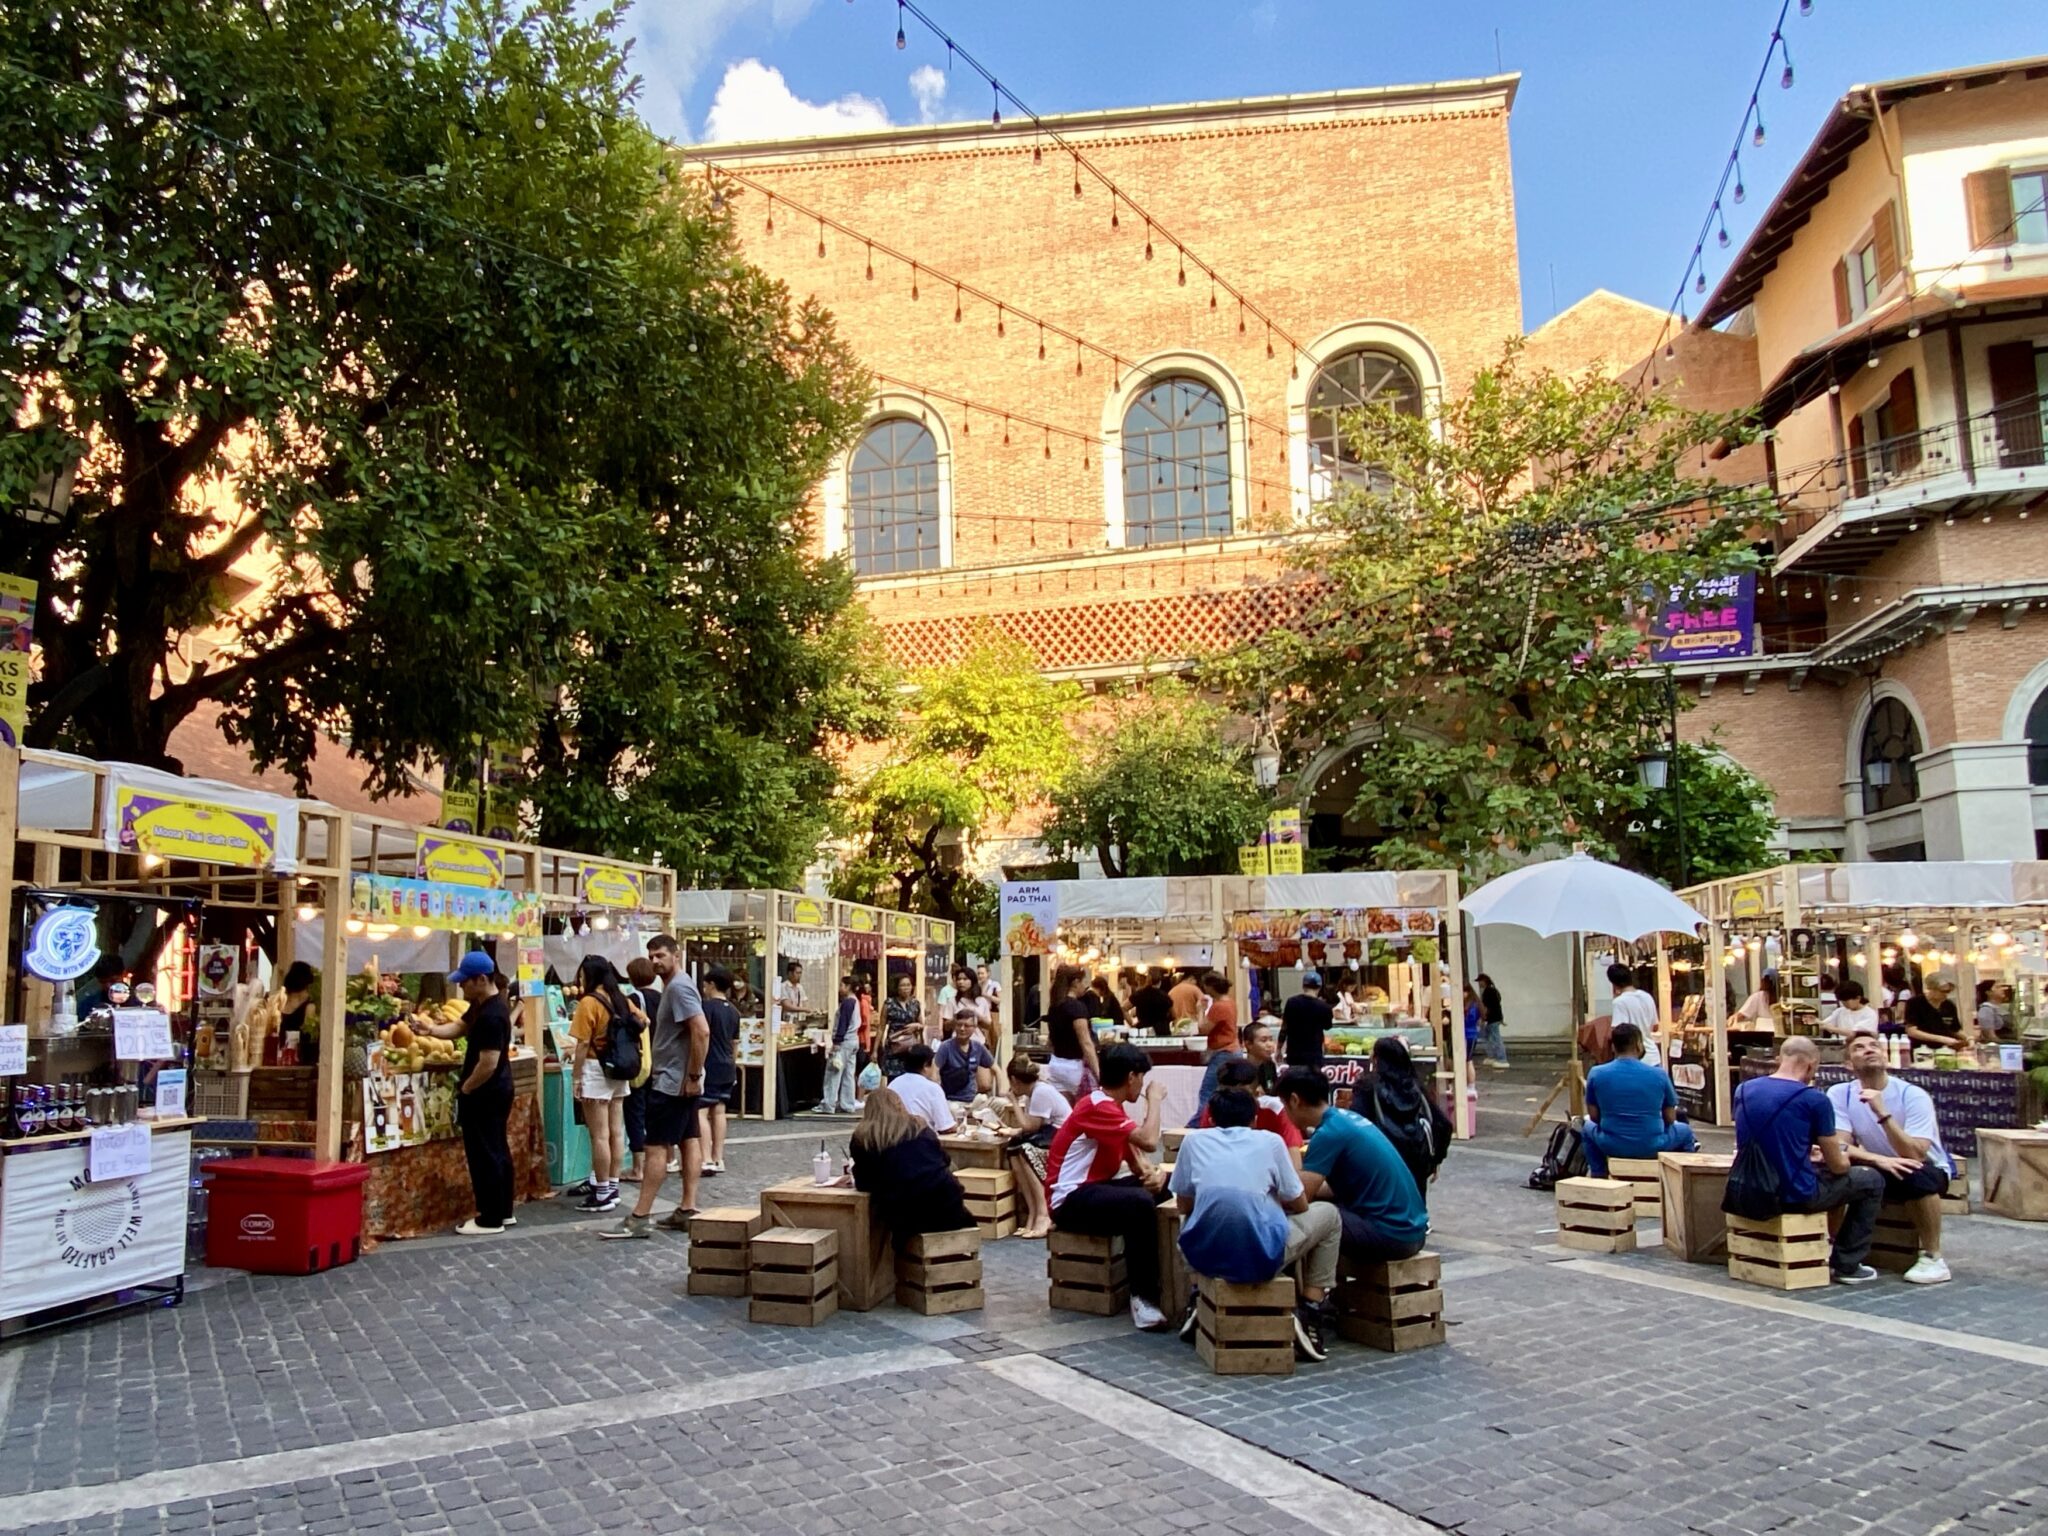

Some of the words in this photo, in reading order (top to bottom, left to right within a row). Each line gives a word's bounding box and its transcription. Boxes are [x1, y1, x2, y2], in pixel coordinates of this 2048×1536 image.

[153, 825, 184, 840] Moose
[184, 829, 205, 843] Thai
[227, 837, 249, 849] Cider
[1007, 895, 1027, 903] PAD
[1028, 895, 1051, 903] THAI
[1018, 886, 1040, 894] ARM
[1321, 1060, 1364, 1084] ork
[69, 1168, 93, 1192] MO
[117, 1215, 143, 1250] WELL
[61, 1246, 116, 1269] CRAFTED
